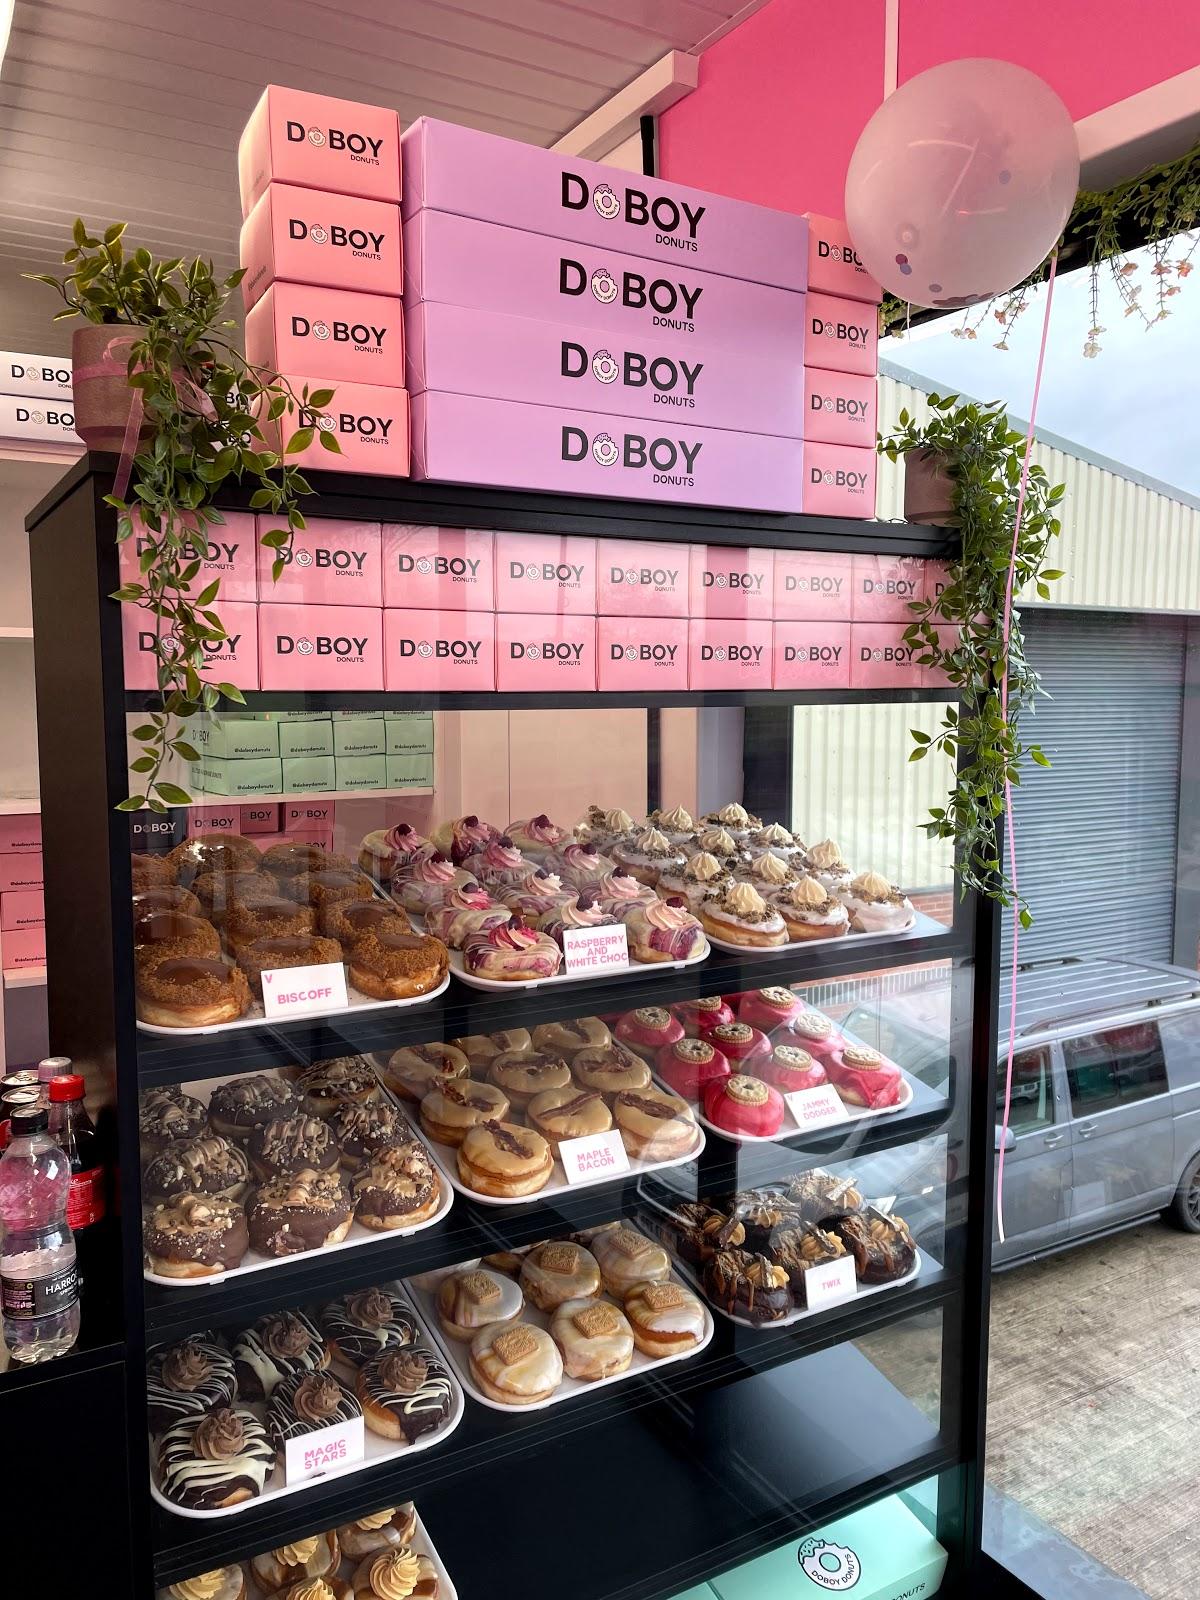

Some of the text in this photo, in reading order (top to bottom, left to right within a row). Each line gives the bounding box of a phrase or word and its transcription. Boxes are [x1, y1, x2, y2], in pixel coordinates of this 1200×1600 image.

[350, 154, 380, 166] DONUTS
[655, 233, 698, 252] DONUTS
[352, 250, 382, 261] DONUTS
[818, 240, 863, 266] DOBO
[652, 316, 695, 333] DONUTS
[354, 345, 383, 354] DONUTS
[11, 364, 73, 383] DOBO
[653, 393, 695, 408] DONUTS
[16, 408, 75, 427] DOBO
[360, 436, 390, 445] DONUTS
[653, 473, 694, 487] DONUTS
[204, 562, 235, 570] DONUTS
[335, 569, 364, 577] DONUTS
[336, 655, 364, 663] DONUTS
[567, 934, 625, 951] RASPBERRY
[587, 947, 608, 957] AND
[567, 952, 628, 968] WHITE CHOC
[265, 974, 274, 985] V
[277, 986, 332, 1005] BISCOFF
[802, 1098, 829, 1111] JAMMY
[803, 1105, 837, 1120] DODGER
[576, 1147, 611, 1163] MAPLE
[578, 1156, 615, 1172] BACON
[821, 1278, 841, 1291] TWIX
[304, 1439, 346, 1461] MAGIC
[304, 1448, 346, 1470] STARS
[811, 1554, 855, 1586] DOBOY DONUTS
[893, 1582, 926, 1600] ONUTS
